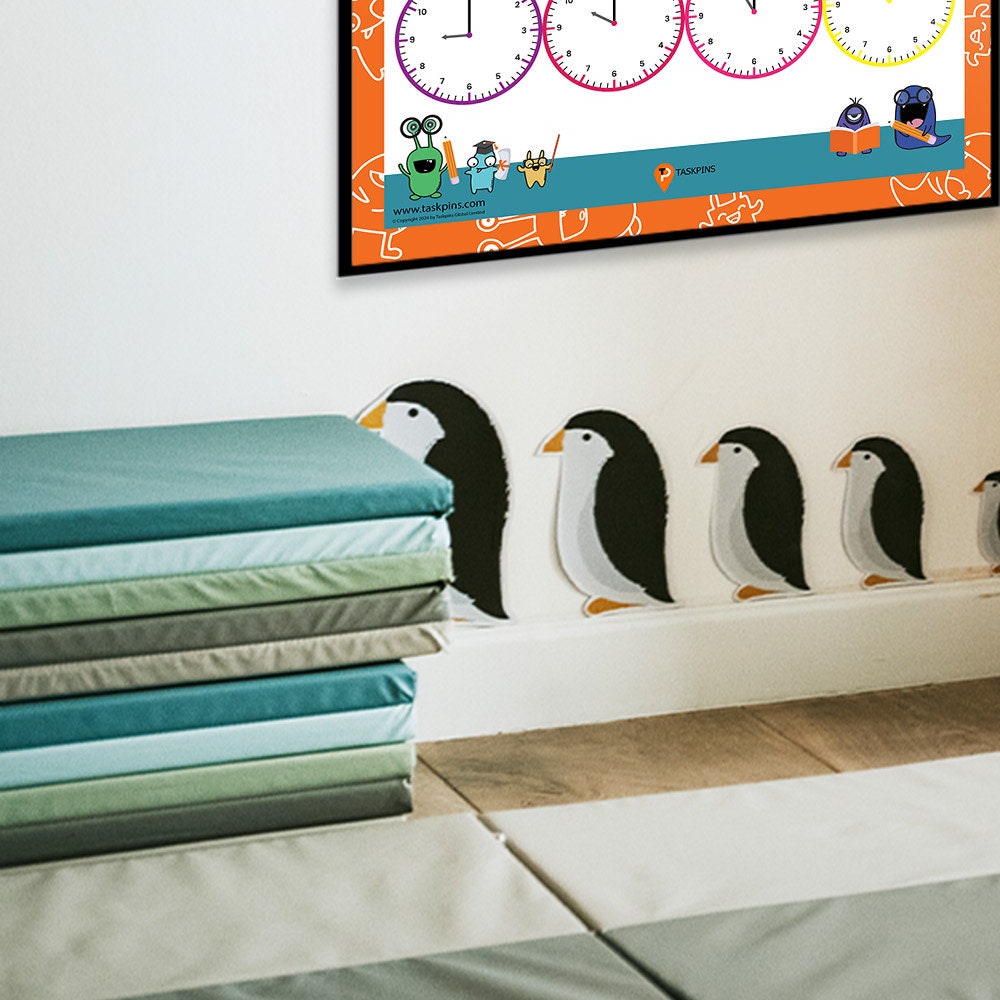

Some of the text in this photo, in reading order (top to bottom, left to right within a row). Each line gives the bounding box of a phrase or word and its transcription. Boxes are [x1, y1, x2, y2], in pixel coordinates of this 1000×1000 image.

[802, 3, 809, 11] 3
[698, 12, 704, 20] 9
[796, 29, 803, 37] 4
[707, 37, 714, 46] 8
[778, 47, 784, 55] 5
[726, 52, 732, 60] 7
[751, 57, 757, 66] 6
[675, 165, 716, 176] TASKPINS
[393, 200, 486, 216] www.taskpins.com
